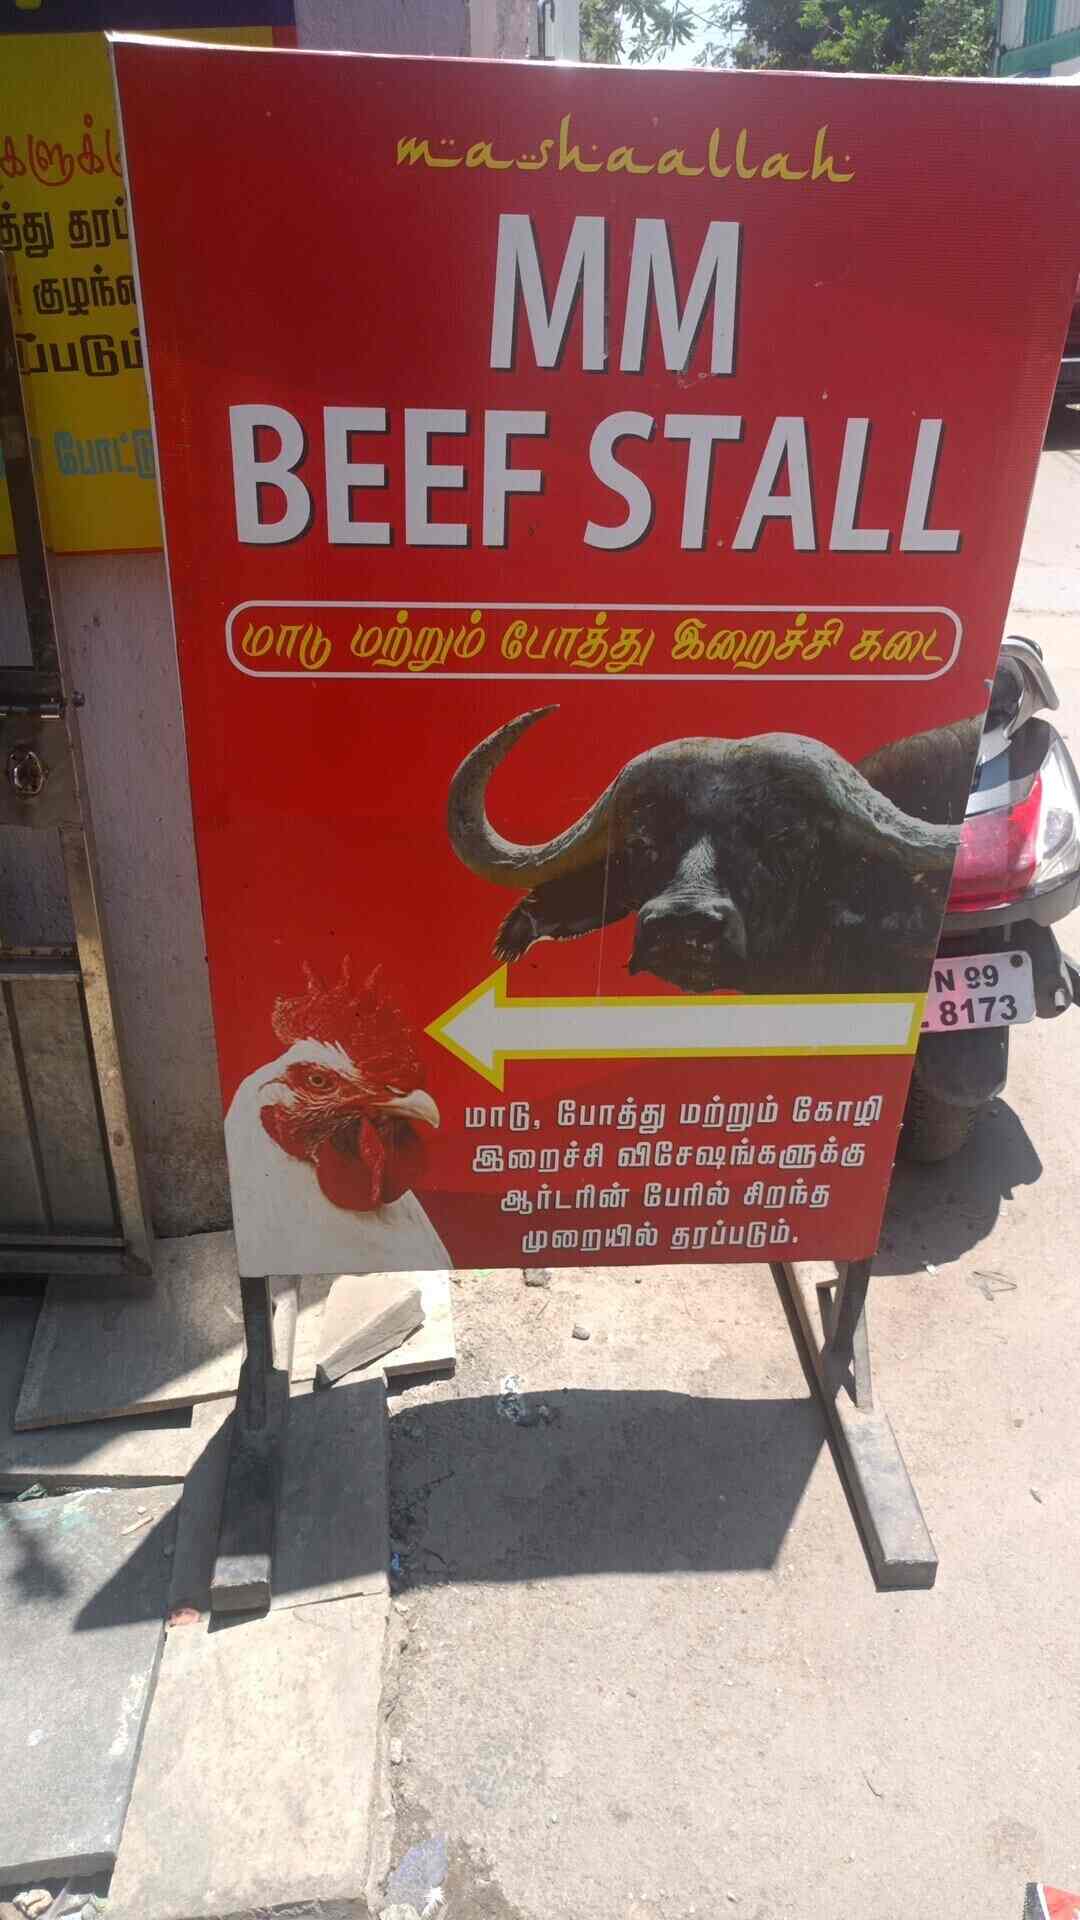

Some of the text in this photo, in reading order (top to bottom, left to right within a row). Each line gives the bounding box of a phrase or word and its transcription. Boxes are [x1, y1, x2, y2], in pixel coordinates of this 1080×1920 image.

[397, 112, 856, 183] mashaallah
[490, 213, 741, 376] MM
[229, 404, 961, 553] BEEF STALL
[241, 609, 943, 674] மாடு மற்றும் போத்து இறைச்சி கடை
[964, 964, 1000, 990] 99
[938, 994, 1018, 1027] 8173
[465, 1094, 883, 1134] மாடு, போத்து மற்றும் கோழி
[472, 1135, 866, 1173] இறைச்சி விசேஷங்களுக்கு
[500, 1177, 831, 1215] ஆர்டரின் பேரில் சிறந்த
[522, 1218, 799, 1253] முறையில் தரப்படும்.
